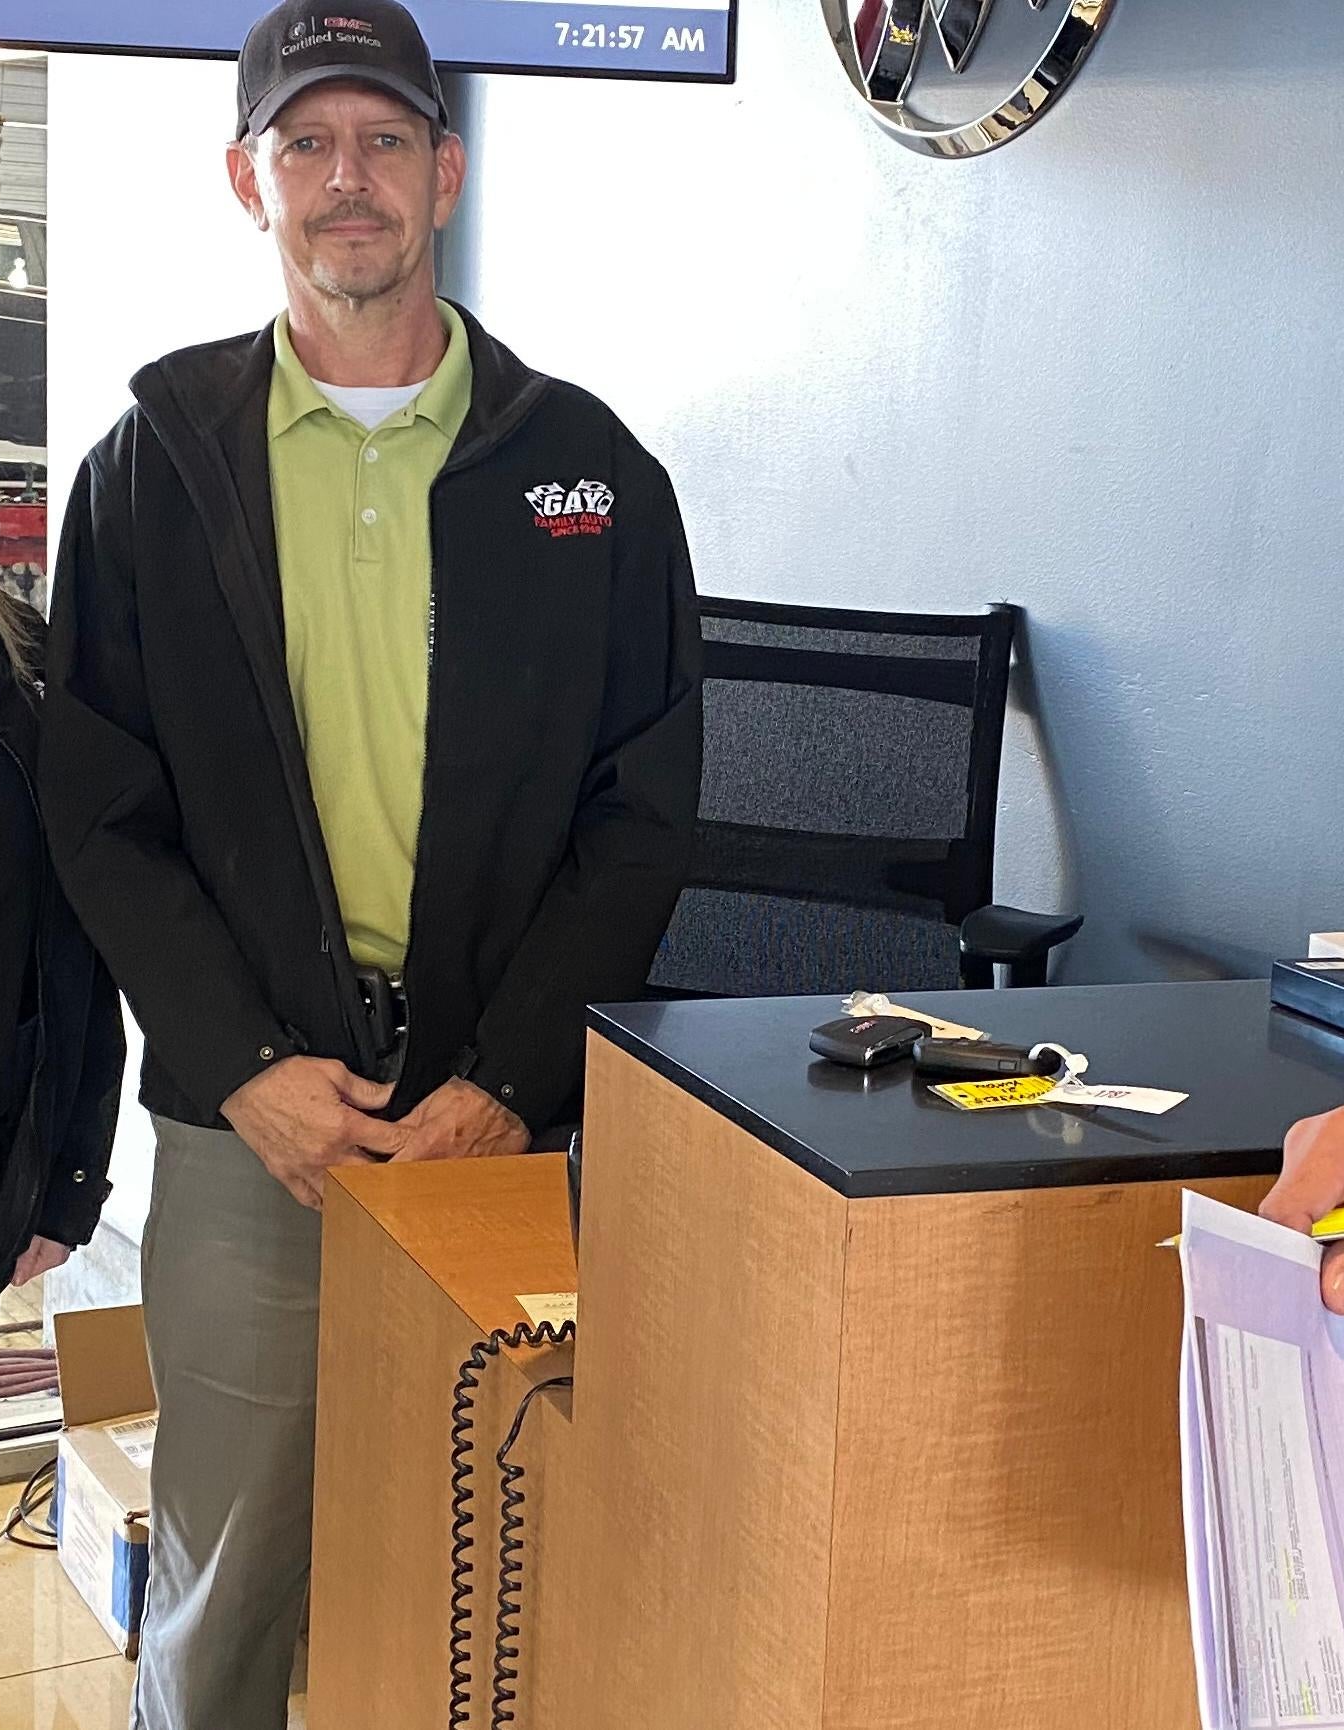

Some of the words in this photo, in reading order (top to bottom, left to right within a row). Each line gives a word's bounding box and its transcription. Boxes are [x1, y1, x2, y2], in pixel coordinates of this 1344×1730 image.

[282, 31, 332, 56] Certified
[336, 32, 382, 48] Service
[554, 22, 645, 49] 7:21:57
[661, 27, 705, 52] AM
[543, 491, 604, 516] GAY
